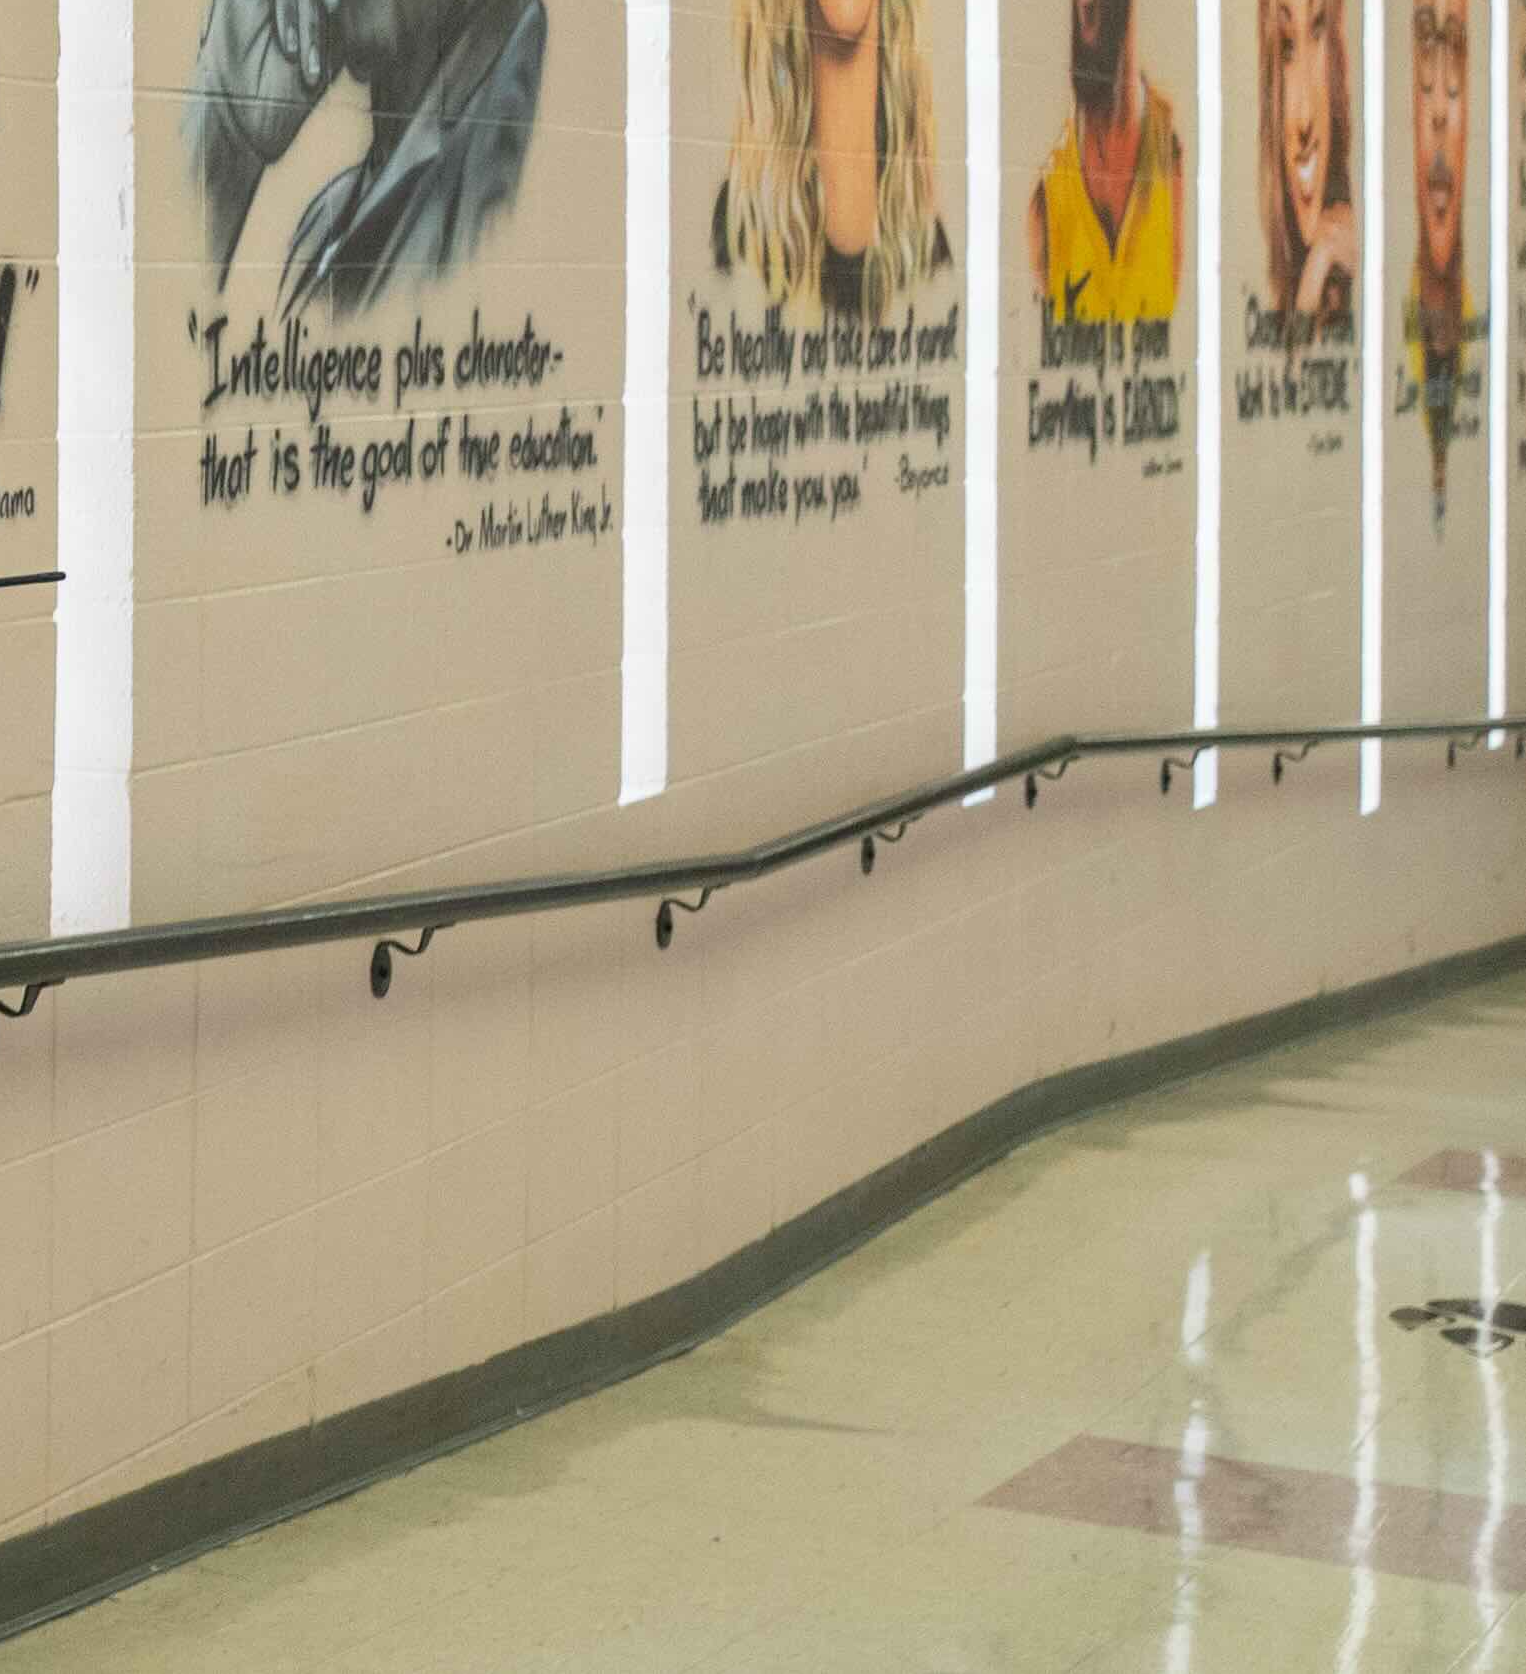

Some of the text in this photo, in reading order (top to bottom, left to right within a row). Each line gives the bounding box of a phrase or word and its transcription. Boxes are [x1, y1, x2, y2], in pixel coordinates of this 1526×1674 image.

[396, 314, 445, 409] plus
[200, 426, 256, 507] that
[271, 428, 300, 492] is
[310, 423, 354, 490] the
[361, 417, 414, 514] goal
[421, 415, 451, 478] of
[459, 413, 500, 480] true
[693, 392, 723, 463] but
[727, 396, 747, 455] be
[479, 501, 523, 550] Martin
[527, 491, 567, 544] Luther
[571, 487, 598, 548] King
[698, 460, 737, 524] that
[741, 453, 788, 519] make
[794, 472, 828, 526] you
